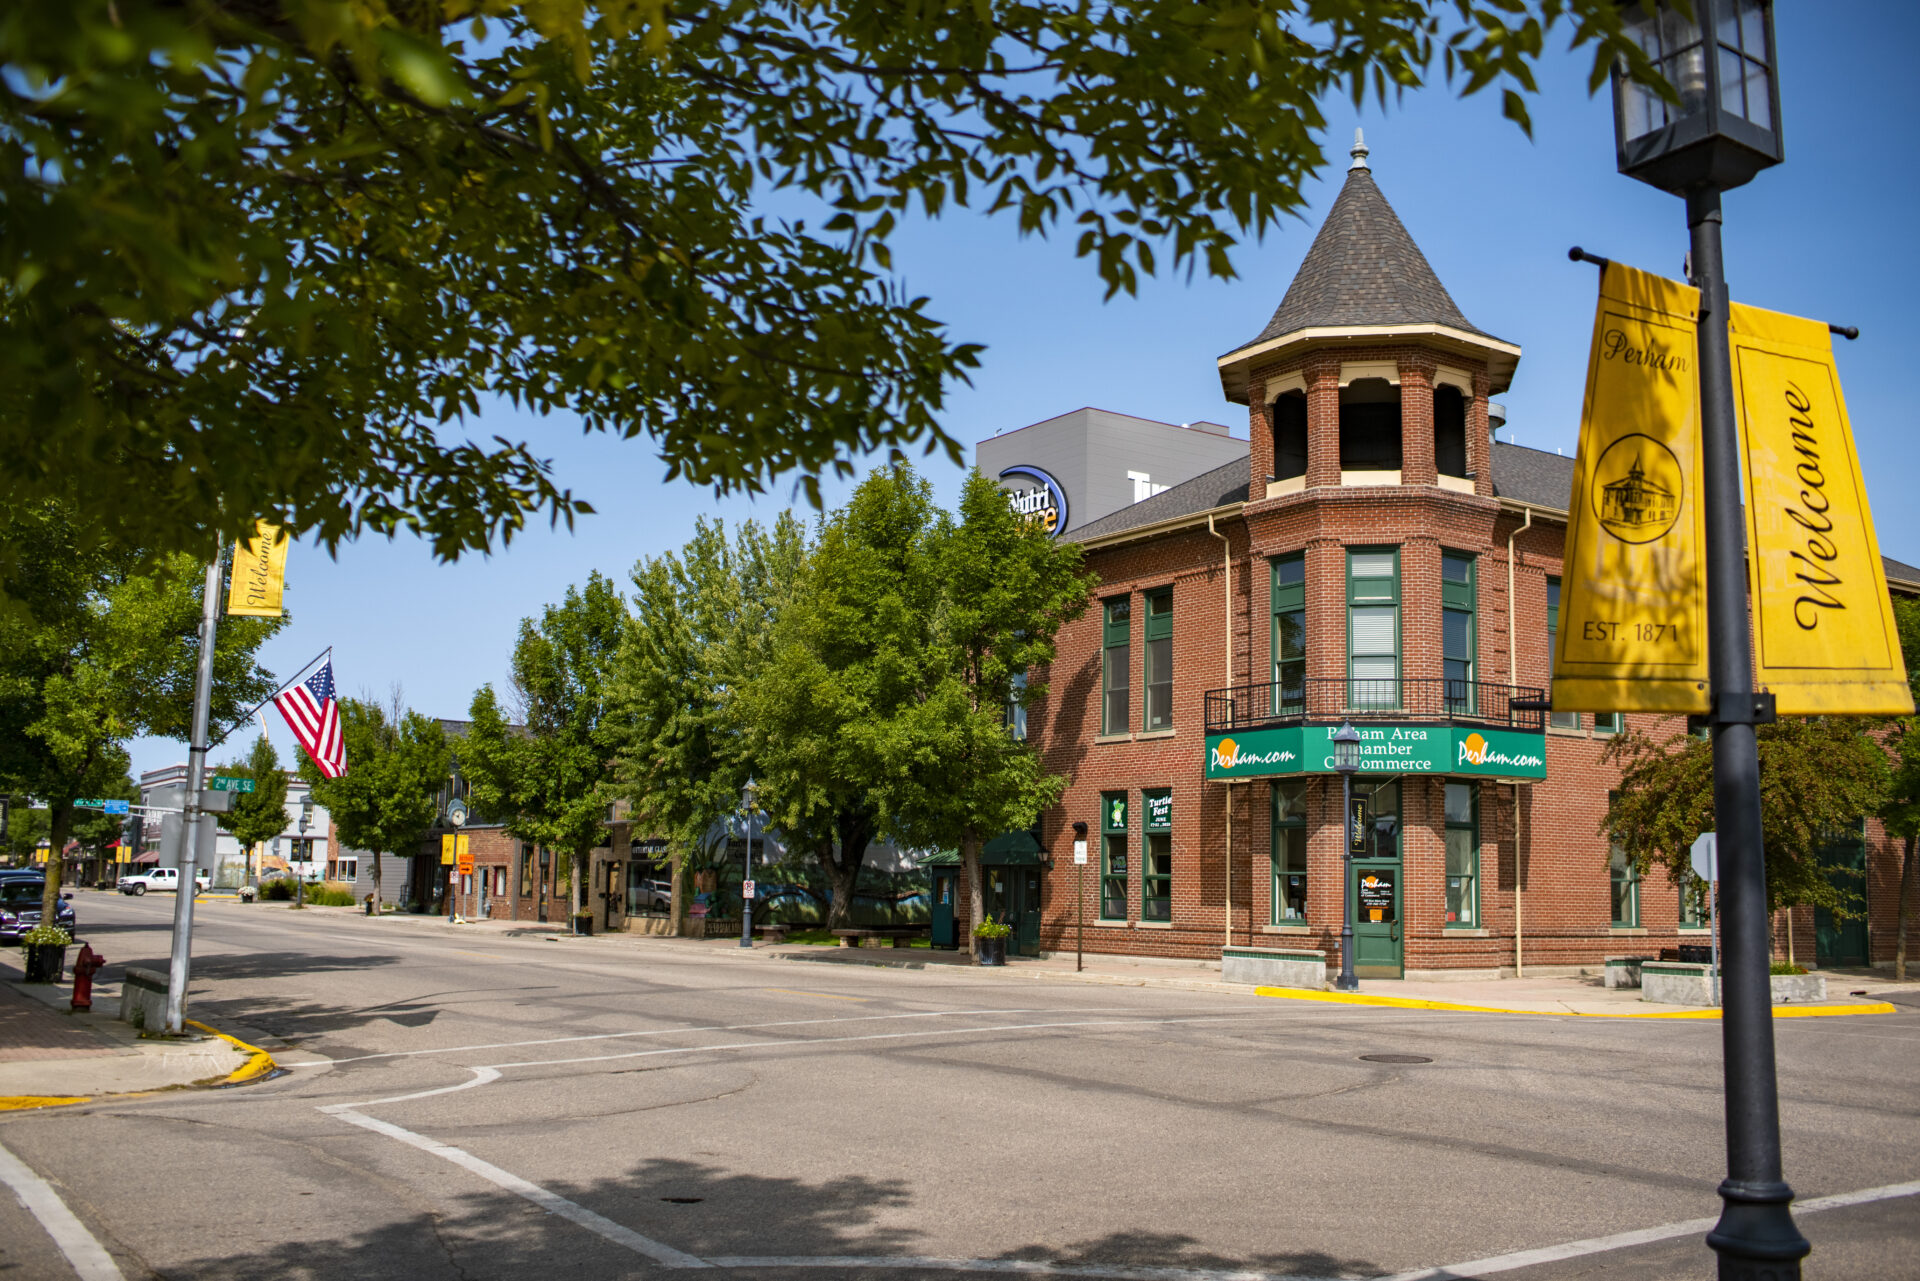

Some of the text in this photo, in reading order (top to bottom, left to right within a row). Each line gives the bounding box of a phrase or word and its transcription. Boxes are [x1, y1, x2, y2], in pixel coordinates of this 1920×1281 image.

[1603, 328, 1690, 373] Perham
[1007, 482, 1050, 514] Nutri
[1783, 379, 1848, 632] Welcome
[246, 530, 273, 605] Welcome
[1582, 620, 1678, 643] EST. 1871
[1326, 727, 1428, 740] Pham Area
[1211, 744, 1296, 772] Perham.com
[1458, 740, 1543, 766] Perham.com
[226, 779, 240, 791] AVE
[242, 780, 252, 791] SE
[1149, 796, 1172, 808] Turtle
[1153, 805, 1169, 816] Fest
[1353, 802, 1363, 847] Welcome
[1361, 878, 1392, 889] Perham
